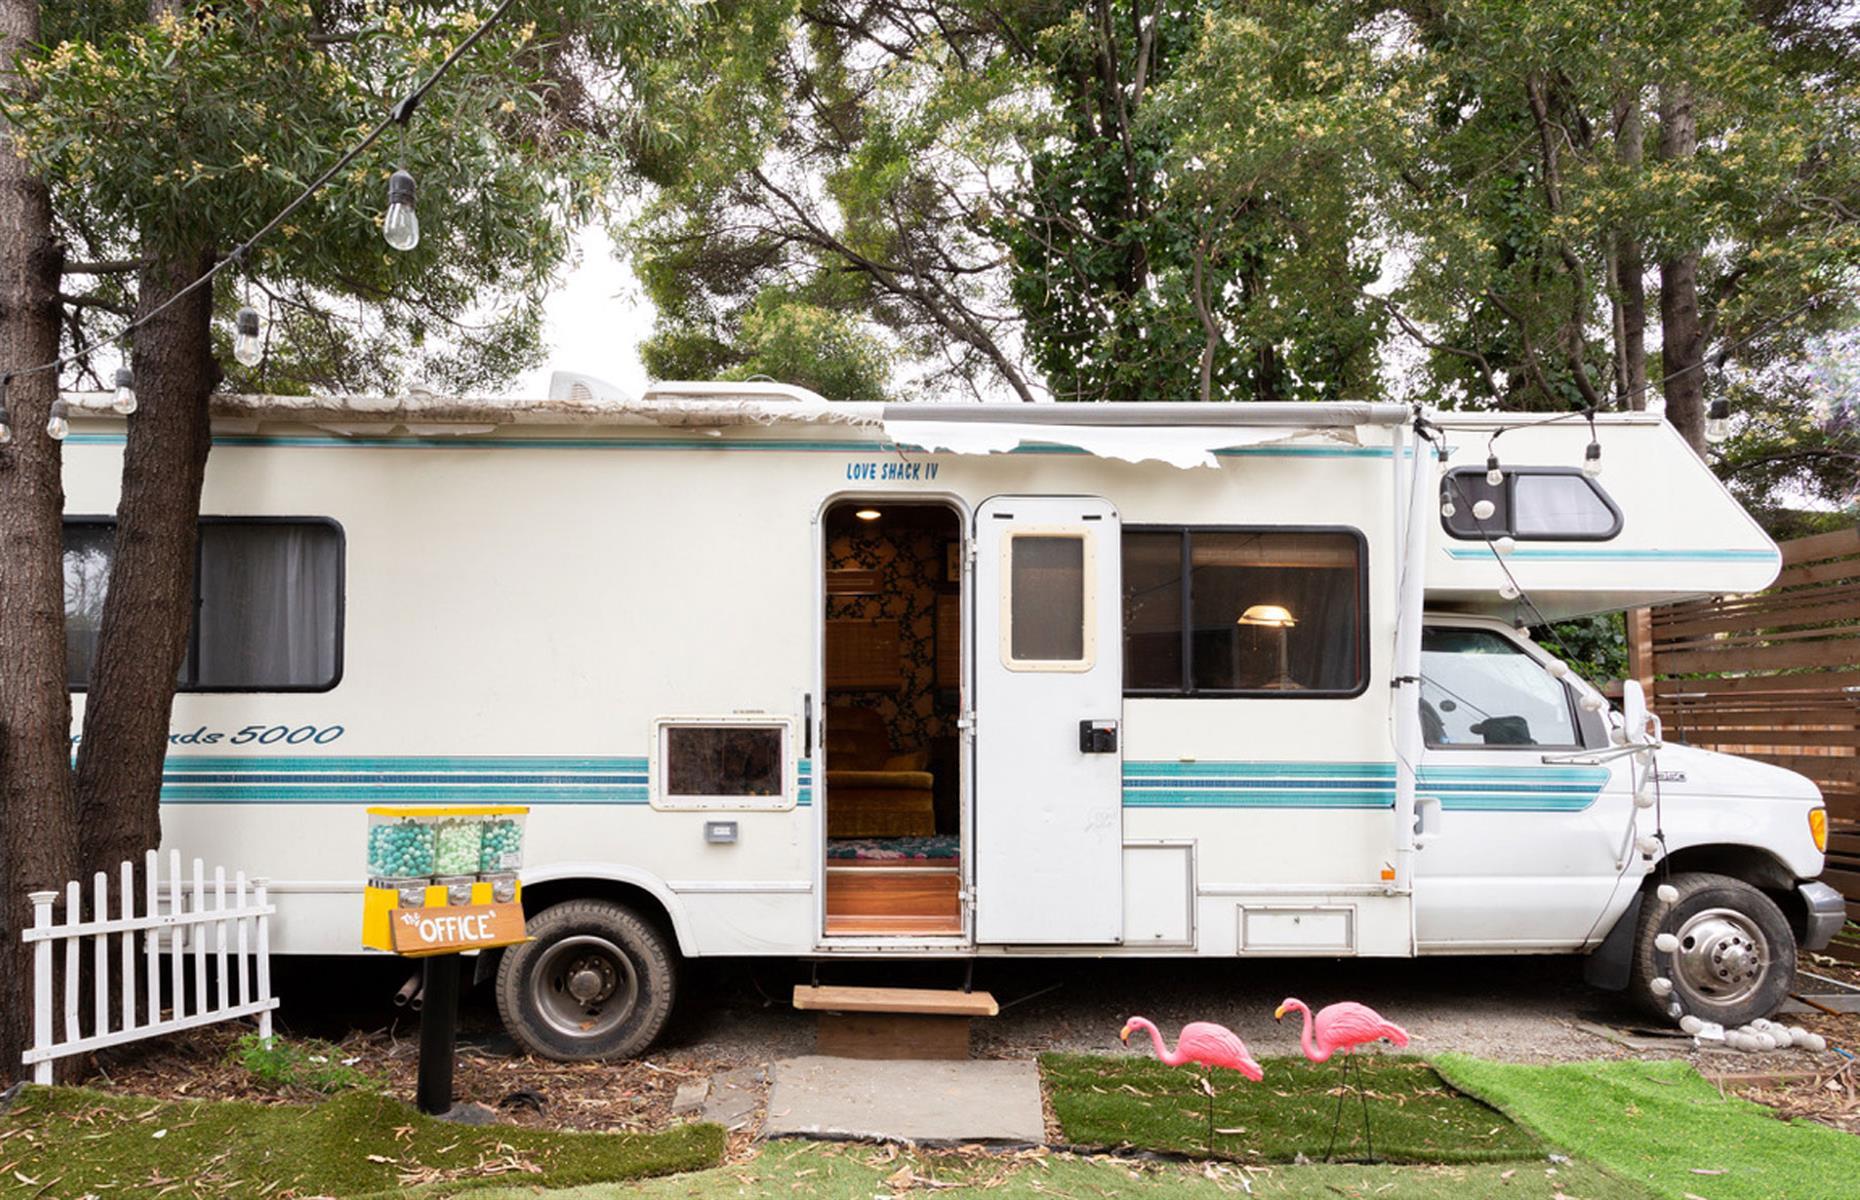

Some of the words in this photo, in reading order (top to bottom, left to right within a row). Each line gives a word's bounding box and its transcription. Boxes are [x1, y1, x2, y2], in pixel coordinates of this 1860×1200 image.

[846, 463, 876, 480] LOVE
[881, 463, 920, 480] SHACK
[925, 463, 939, 480] IV
[230, 725, 344, 744] 5000
